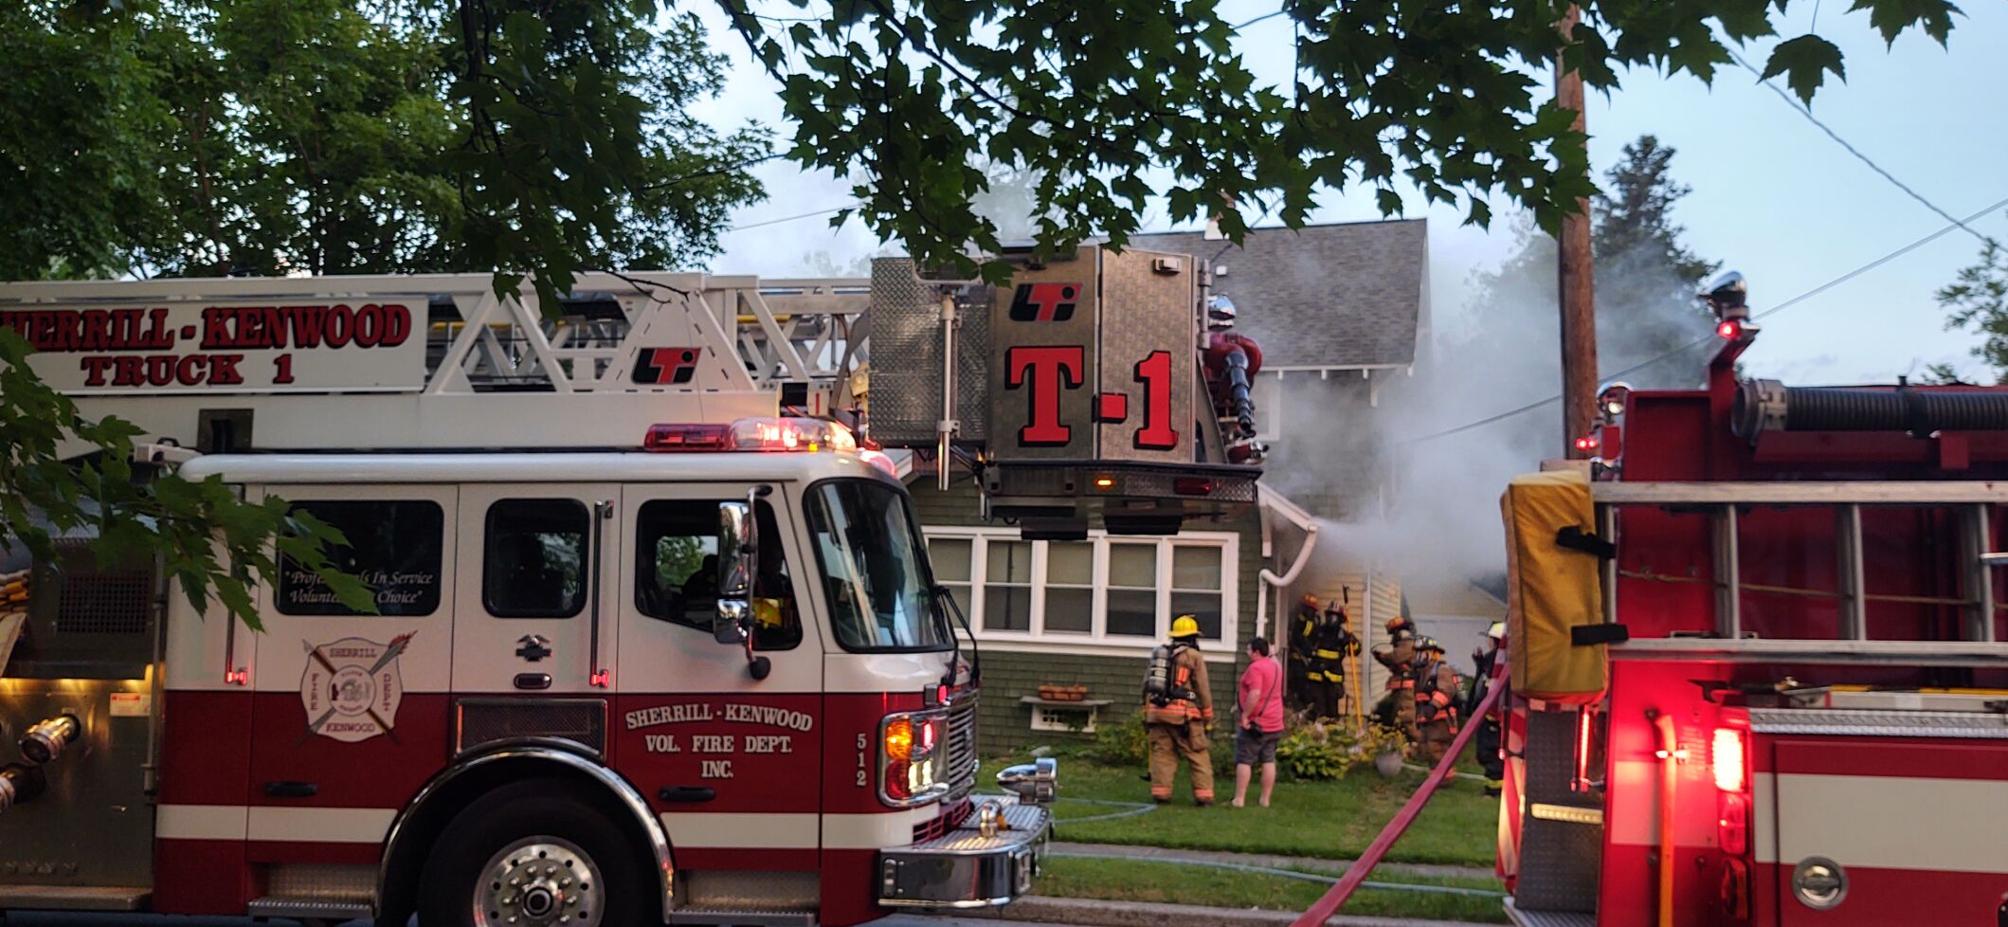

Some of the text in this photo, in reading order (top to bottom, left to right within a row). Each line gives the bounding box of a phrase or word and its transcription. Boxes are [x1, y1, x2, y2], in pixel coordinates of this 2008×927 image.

[80, 353, 294, 387] TRUCK 1
[1005, 345, 1179, 451] T-1
[372, 571, 388, 584] In
[390, 570, 434, 585] Service
[645, 735, 792, 753] VOL. FIRE DEPT.
[700, 760, 734, 778] INC.
